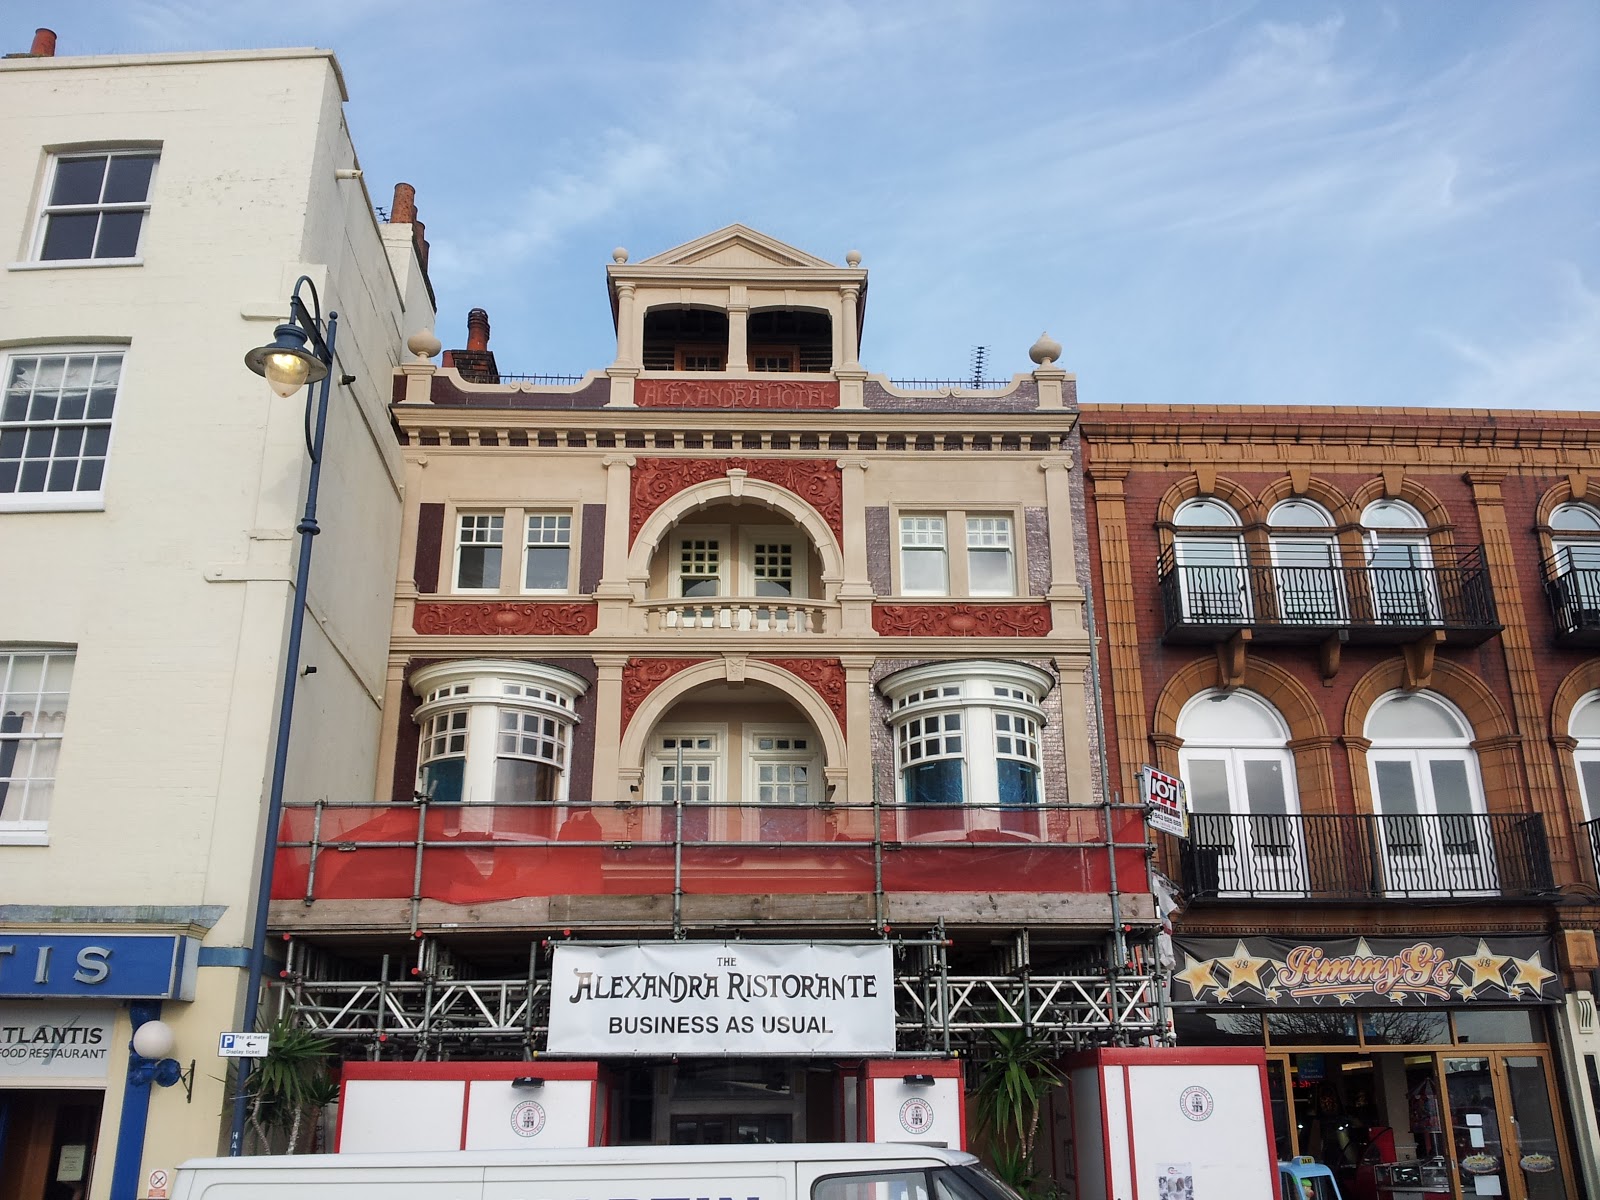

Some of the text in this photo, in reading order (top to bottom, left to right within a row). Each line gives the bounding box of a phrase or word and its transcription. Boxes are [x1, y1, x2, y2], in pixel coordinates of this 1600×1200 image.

[639, 382, 834, 407] ALEXANDRA HOTEL
[1151, 778, 1176, 801] IOT
[717, 957, 736, 967] THE
[569, 968, 877, 1003] ALEXANDRA RISTORANTE
[609, 1016, 833, 1034] BUSINESS AS USUAL
[0, 1027, 103, 1044] TLANTIS
[29, 1049, 107, 1059] RESTAURANT
